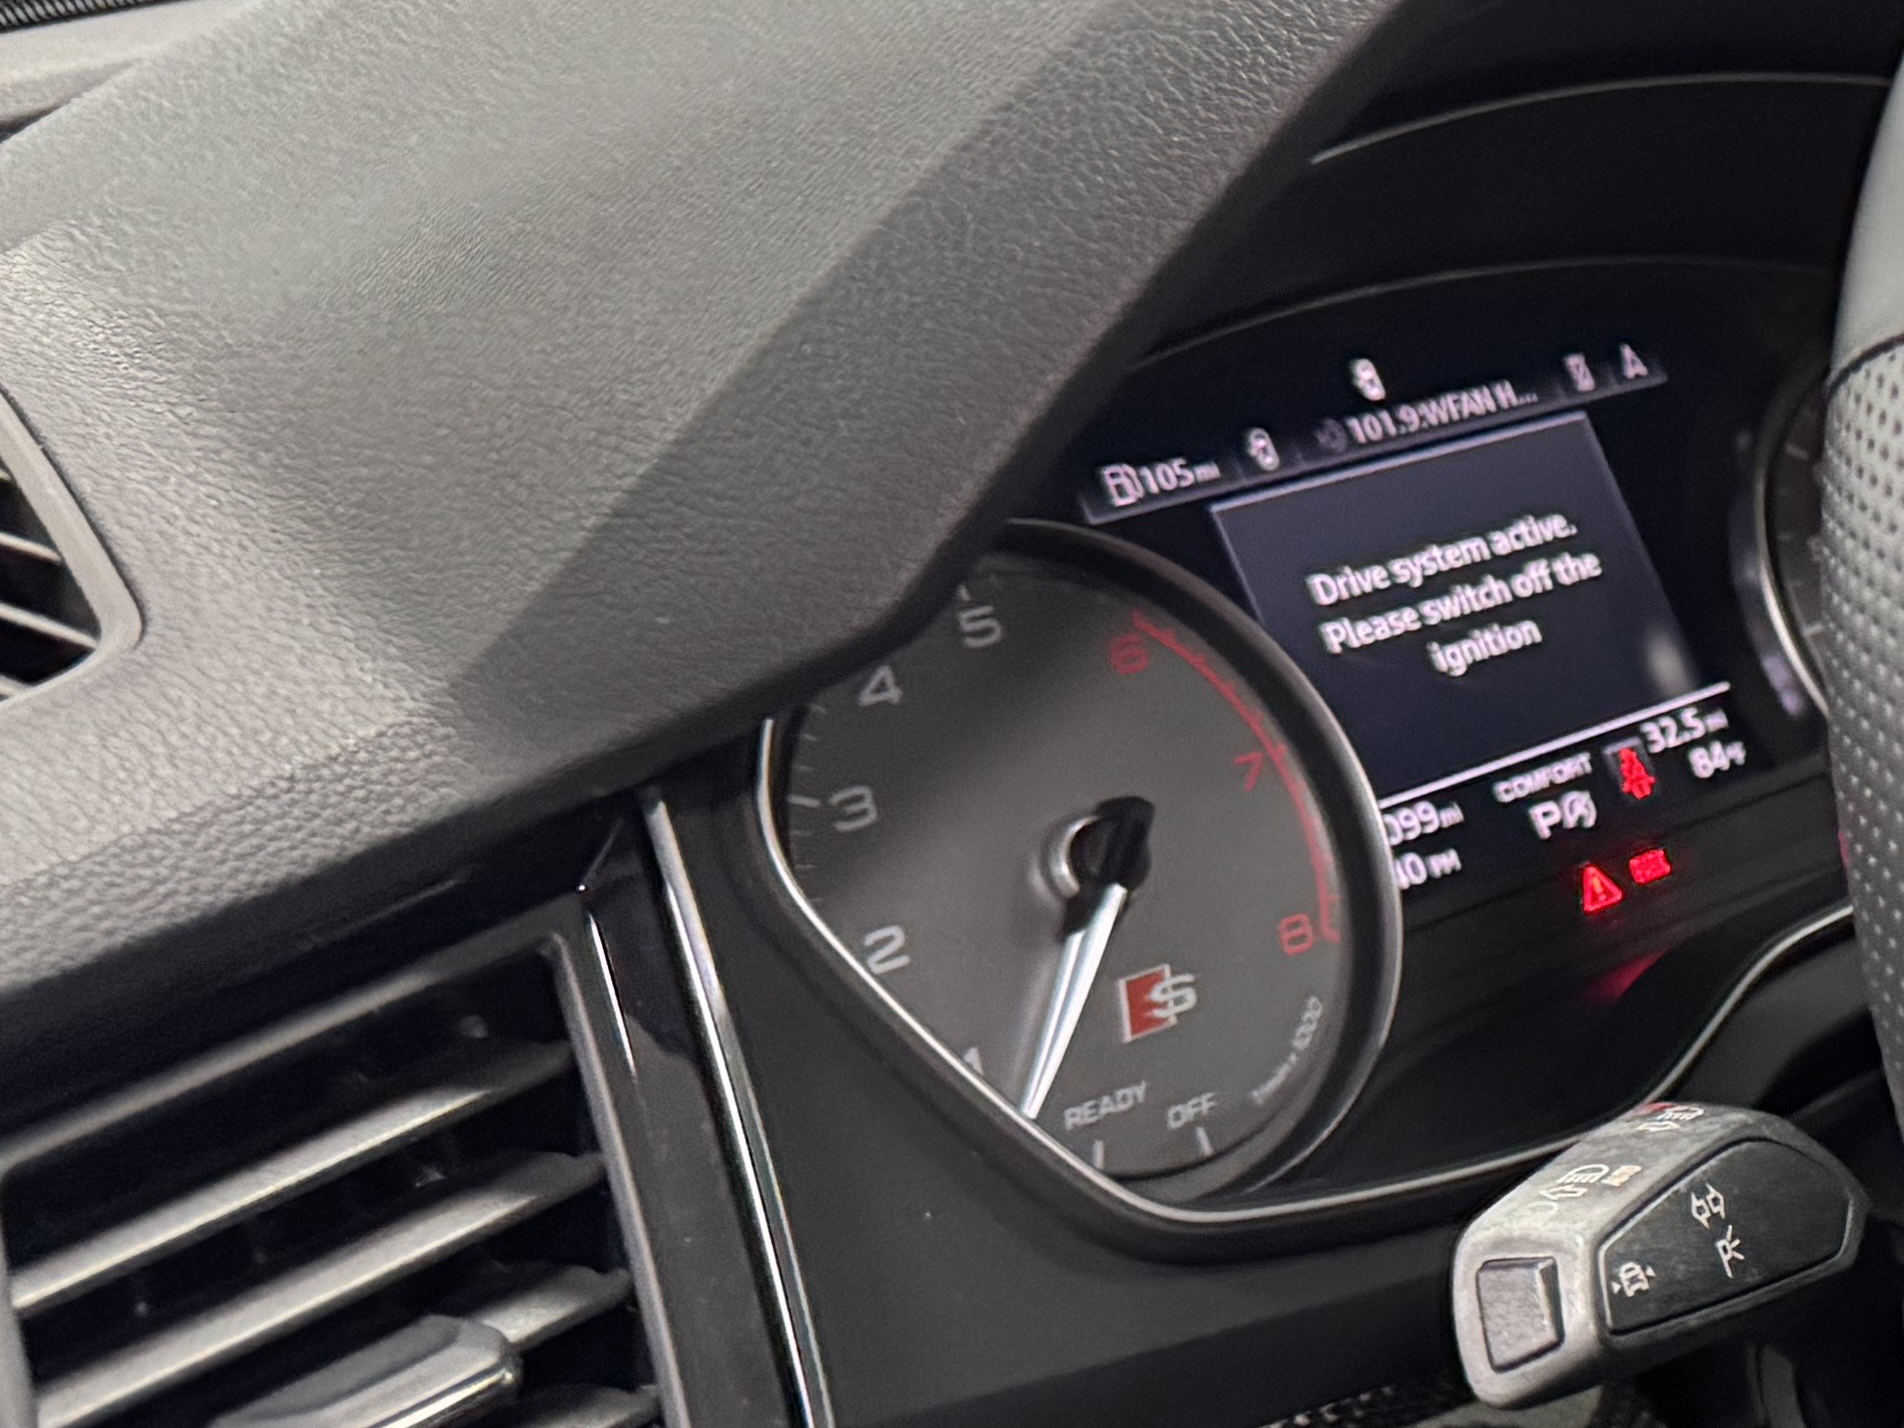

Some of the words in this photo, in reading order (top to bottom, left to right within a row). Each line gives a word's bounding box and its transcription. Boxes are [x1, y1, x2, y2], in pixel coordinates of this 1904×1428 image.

[1306, 565, 1391, 606] Drive
[1388, 536, 1492, 588] system
[1489, 513, 1578, 556] active.
[958, 605, 1002, 649] 5
[1321, 606, 1422, 654] Please
[1418, 574, 1513, 626] switch
[1510, 558, 1553, 599] off
[1552, 552, 1602, 586] the
[1426, 620, 1543, 677] ignition
[857, 665, 902, 708] 4
[1233, 751, 1268, 794] 7
[829, 784, 878, 833] 3
[863, 924, 911, 974] 2
[1278, 914, 1315, 955] 8
[1064, 1080, 1147, 1131] READY
[1167, 1092, 1217, 1130] OFF
